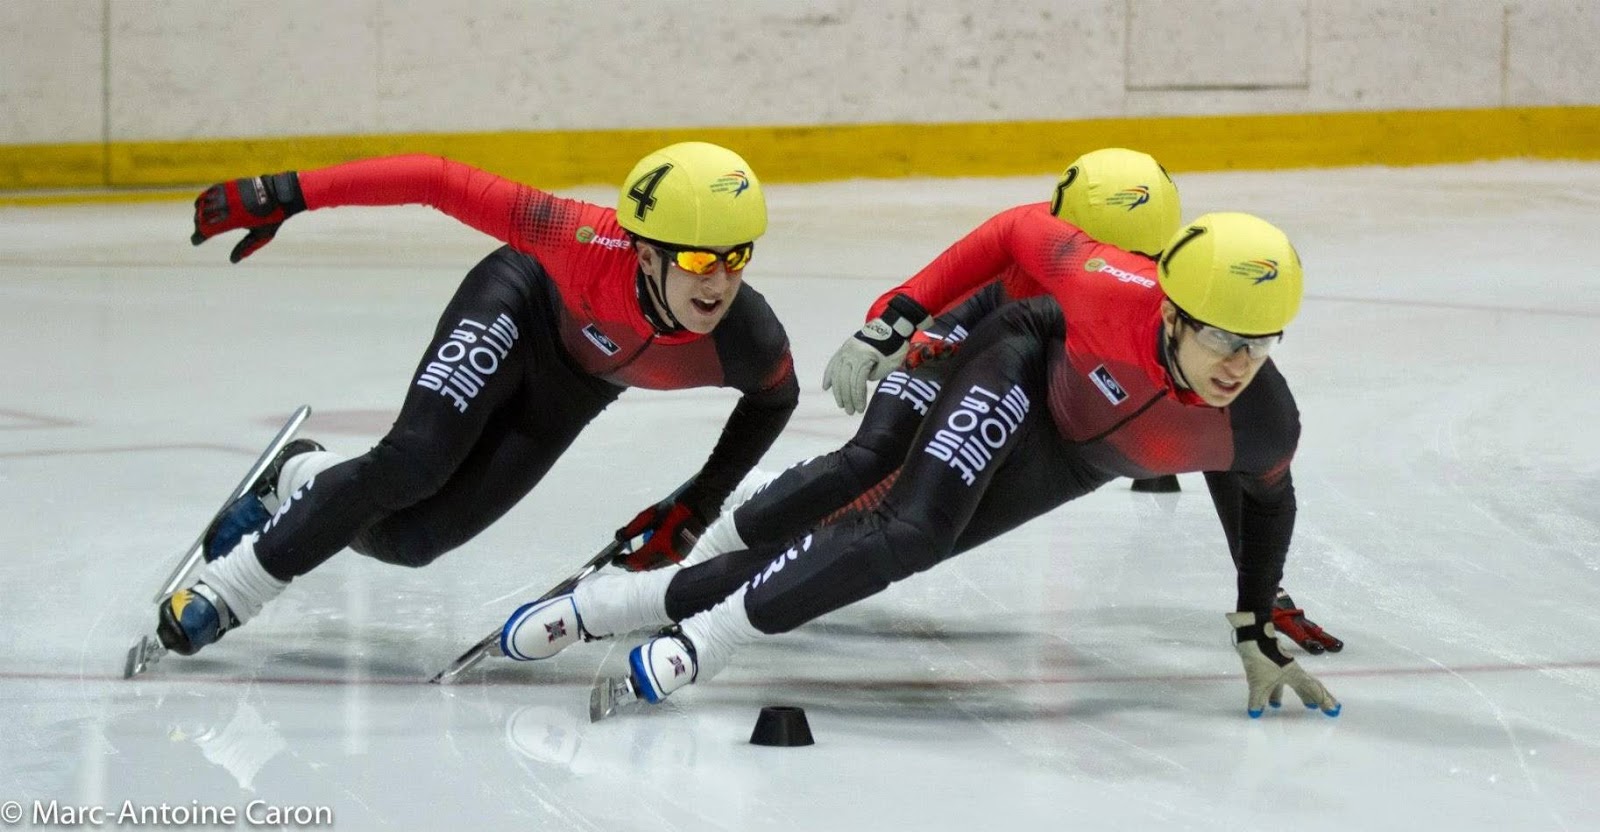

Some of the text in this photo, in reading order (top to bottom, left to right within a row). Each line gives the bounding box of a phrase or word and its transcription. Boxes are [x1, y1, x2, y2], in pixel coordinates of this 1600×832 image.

[627, 162, 673, 222] 4
[1084, 257, 1157, 289] apogee
[1161, 226, 1207, 278] 1
[949, 384, 1030, 486] ANTOINE
